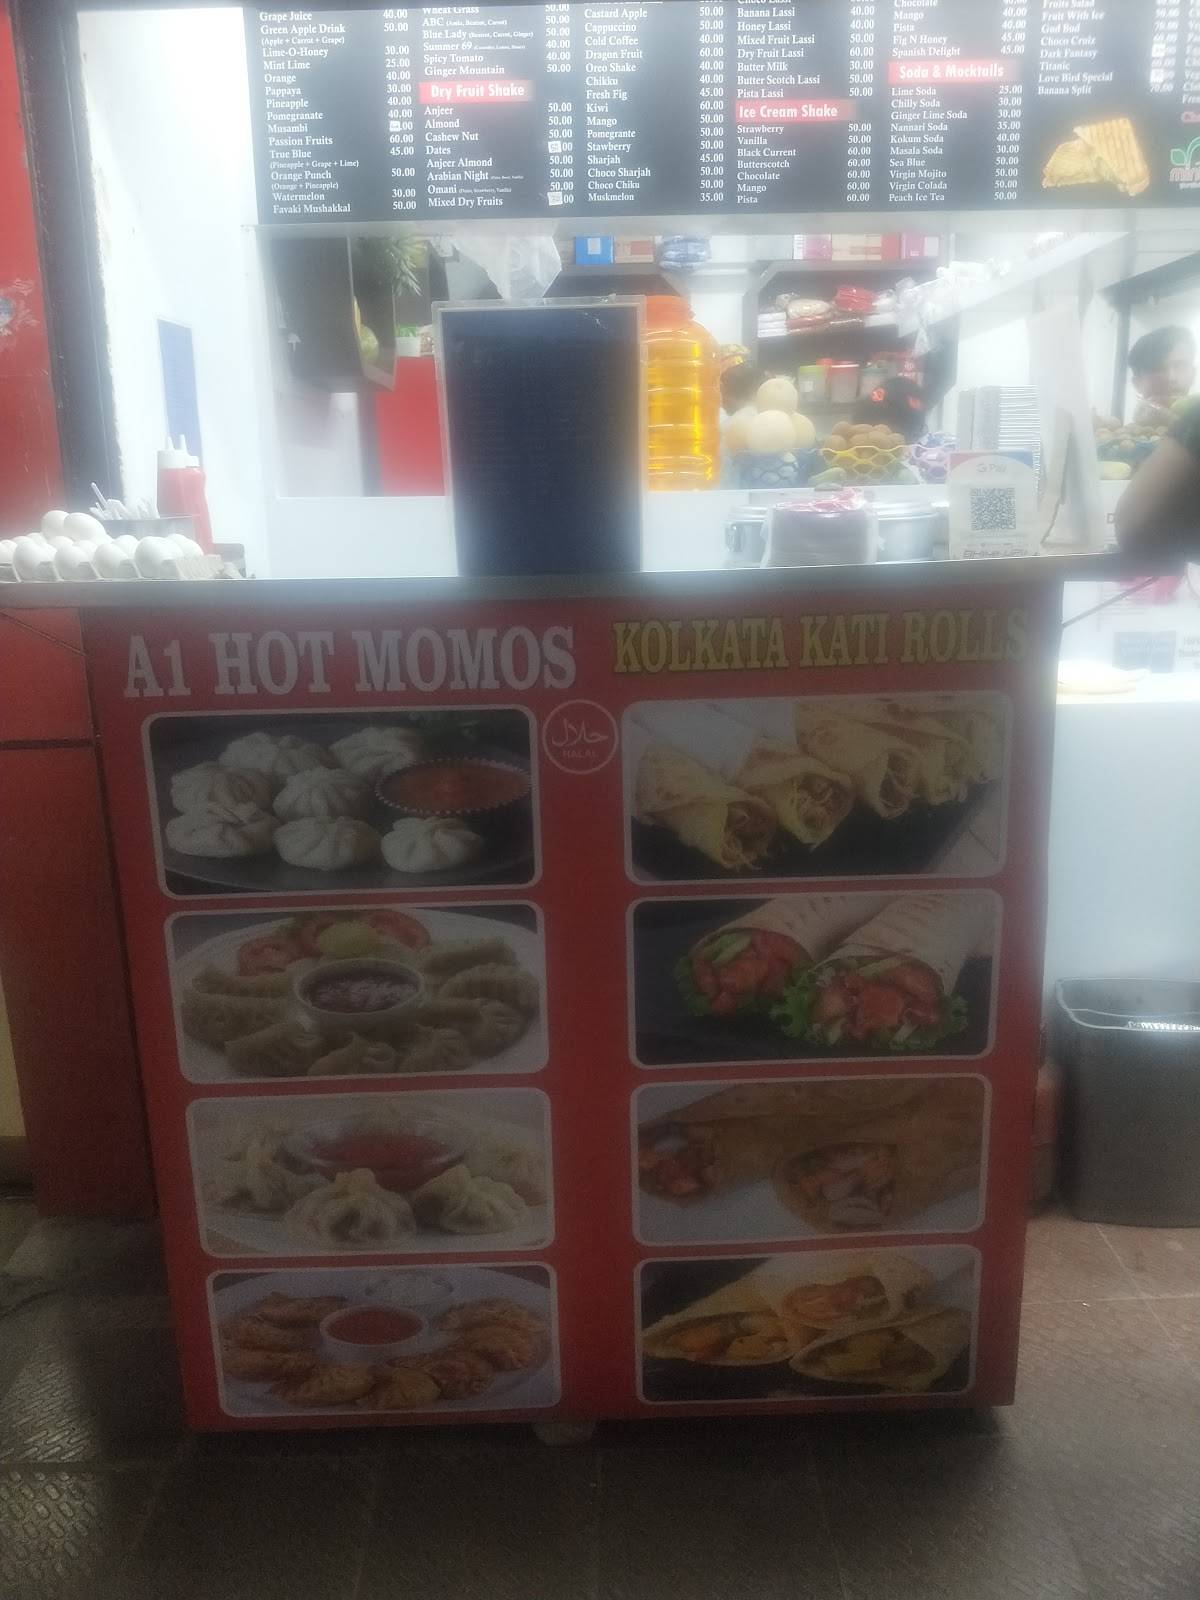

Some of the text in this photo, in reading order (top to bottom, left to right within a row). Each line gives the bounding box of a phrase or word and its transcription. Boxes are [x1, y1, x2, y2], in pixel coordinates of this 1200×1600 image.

[260, 9, 407, 21] Grape Juice 40.00
[738, 9, 795, 17] Banana Lassi
[894, 12, 924, 21] Mango
[422, 19, 443, 27] ABC
[738, 22, 791, 33] Honey Lassi
[261, 24, 345, 34] Green Apple Drink
[585, 24, 636, 34] Cappuccino
[893, 24, 915, 32] Pista
[423, 31, 443, 39] Blue
[445, 31, 467, 41] Lady
[738, 35, 815, 44] Mixed Fruit Lassi
[1002, 33, 1025, 42] 45.00
[585, 37, 639, 46] Cold Coffee
[424, 43, 459, 51] Summer
[263, 48, 328, 57] Lime-O-Honey
[586, 50, 643, 60] Dragon Fruit
[738, 49, 804, 59] Dry Fruit Lassi
[1040, 49, 1098, 59] Dark Fantasy
[424, 53, 571, 65] Spicy Tomato 40.00
[264, 61, 310, 70] Mint Lime
[610, 63, 636, 72] Shake
[700, 62, 723, 70] 40.00
[738, 63, 788, 72] Butter Milk
[1040, 62, 1070, 70] Titanic
[425, 67, 505, 77] Ginger Mountain
[899, 64, 1004, 79] Soda & Mocktails
[265, 74, 296, 83] Orange
[586, 77, 618, 85] Chikku
[738, 75, 873, 85] Butter Scotch Lassi 50.00
[1039, 72, 1113, 82] Love Bird Special
[265, 87, 301, 96] Pappaya
[431, 84, 525, 99] Dry Fruit Shake
[738, 90, 784, 98] Pista Lassi
[892, 87, 936, 96] Lime Soda
[1038, 86, 1091, 96] Banana Split
[587, 91, 627, 101] Fresh Fig
[266, 97, 411, 108] Pineapple 40.00
[891, 99, 940, 109] Chilly Soda
[424, 106, 453, 116] Anjeer
[587, 104, 608, 113] Kiwi
[739, 105, 838, 118] Ice Cream Shake
[267, 112, 323, 121] Pomegranate
[891, 111, 967, 120] Ginger Lime Soda
[425, 120, 459, 128] Almond
[587, 117, 617, 127] Mango
[891, 122, 1021, 131] Nannari Soda 35.00
[268, 124, 308, 133] Musambi
[700, 128, 723, 136] 50.00
[738, 125, 784, 134] Strawberry
[269, 136, 333, 146] Passion Fruits
[426, 132, 479, 141] Cashew Nut
[738, 137, 767, 145] Vanilla
[890, 135, 944, 143] Kokum Soda
[270, 150, 311, 158] True Blue
[426, 146, 451, 155] Dates
[738, 149, 761, 157] Black
[890, 146, 943, 155] Masala Soda
[427, 158, 492, 168] Anjeer Almond
[588, 156, 620, 166] Sharjah
[890, 158, 925, 166] Sea Blue
[271, 171, 331, 182] Orange Punch
[427, 172, 462, 181] Arabian
[464, 172, 489, 182] Night
[550, 170, 573, 178] 50.00
[588, 169, 651, 179] Choco Sharjah
[738, 171, 870, 180] Chocolate 60.00
[890, 170, 947, 179] Virgin Mojito
[428, 186, 457, 194] Omani
[588, 181, 640, 190] Choco Chiku
[738, 184, 767, 193] Mango
[889, 181, 947, 191] Virgin Colada
[273, 189, 415, 201] Watermelon 30.00
[700, 193, 723, 201] 35.00
[915, 193, 928, 201] Ice
[930, 193, 944, 201] Tea
[994, 192, 1017, 200] 50.00
[429, 198, 503, 208] Mixed Dry Fruits
[613, 607, 1029, 673] KOLKATA KATI ROLLS
[124, 625, 577, 698] A1 HOT MOMOS
